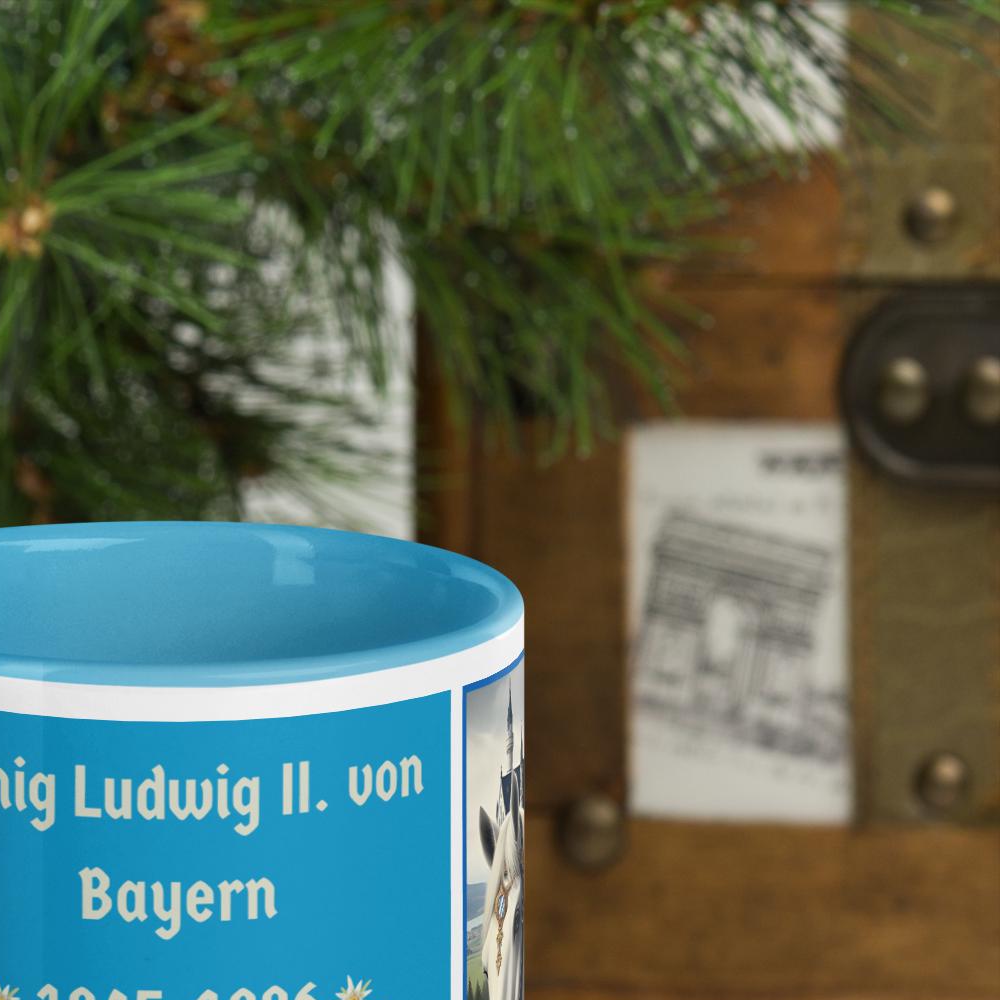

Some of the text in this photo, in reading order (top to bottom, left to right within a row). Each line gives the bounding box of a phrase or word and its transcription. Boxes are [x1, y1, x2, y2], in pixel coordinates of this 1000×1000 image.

[75, 763, 260, 836] Ludwig
[282, 761, 328, 815] II.
[349, 755, 424, 806] von
[79, 867, 277, 940] Bayern
